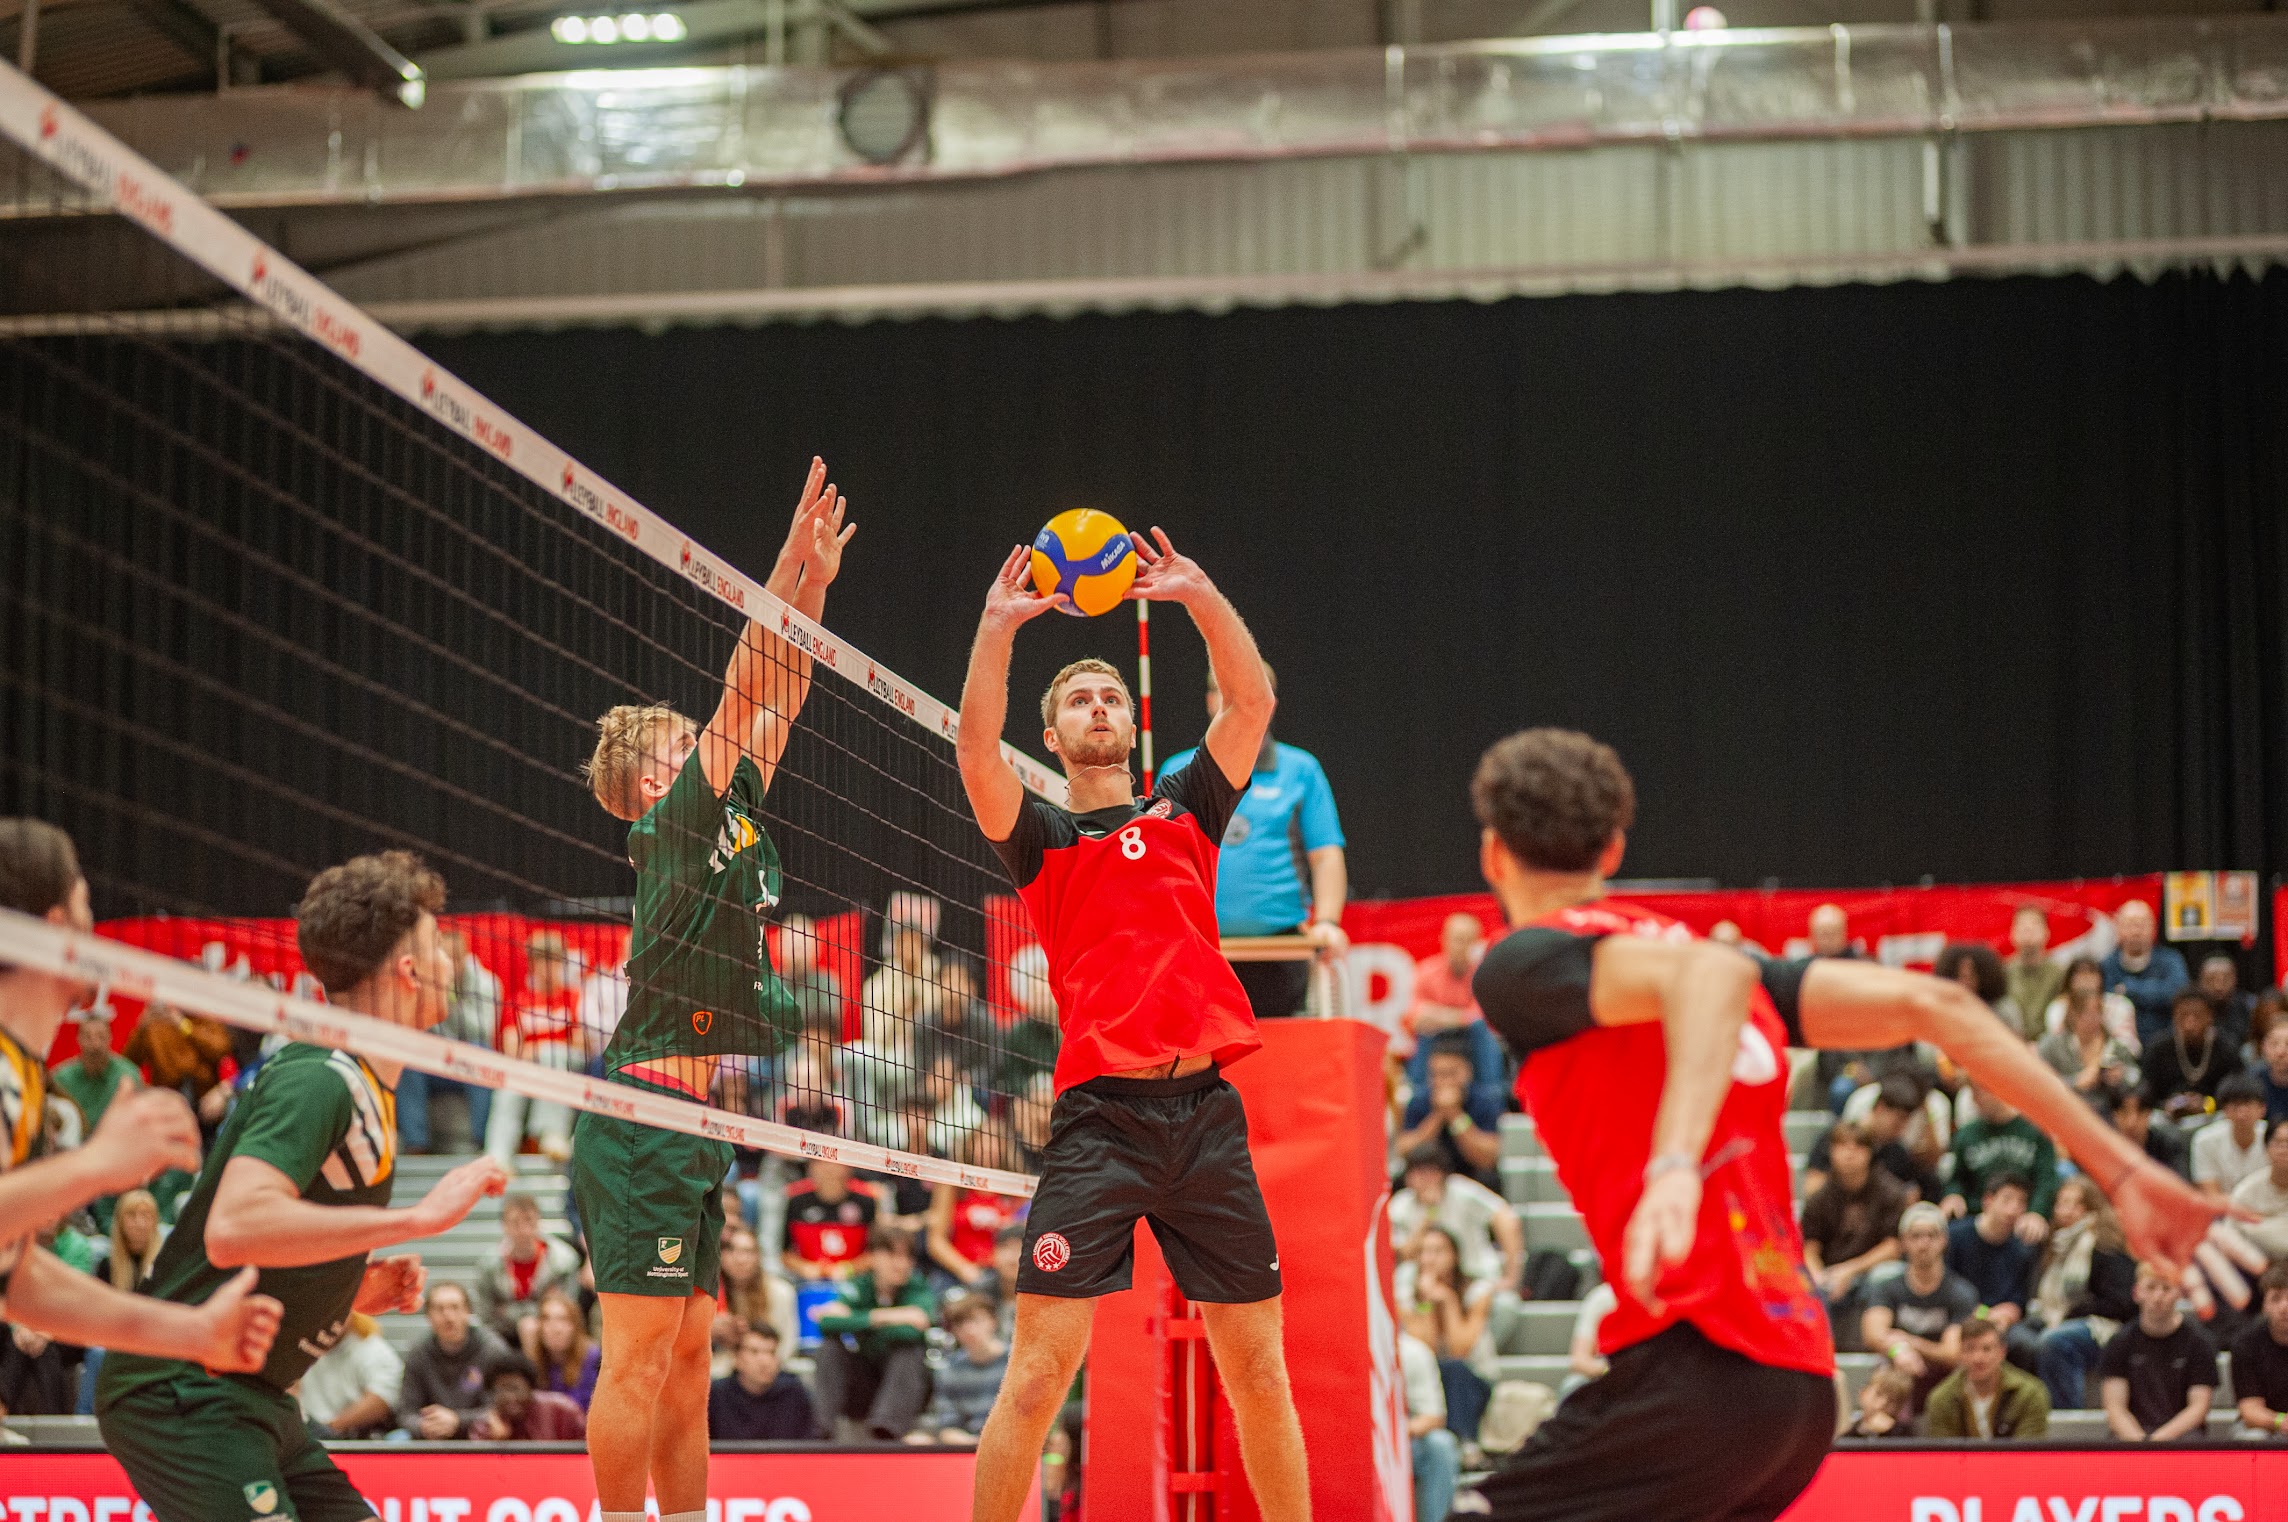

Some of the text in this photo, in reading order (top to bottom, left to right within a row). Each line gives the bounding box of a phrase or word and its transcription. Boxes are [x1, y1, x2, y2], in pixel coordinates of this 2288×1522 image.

[717, 575, 745, 609] ENGLAND
[812, 636, 837, 667] ENGLAND
[894, 688, 915, 717] ENGLAND
[1119, 826, 1146, 860] 8
